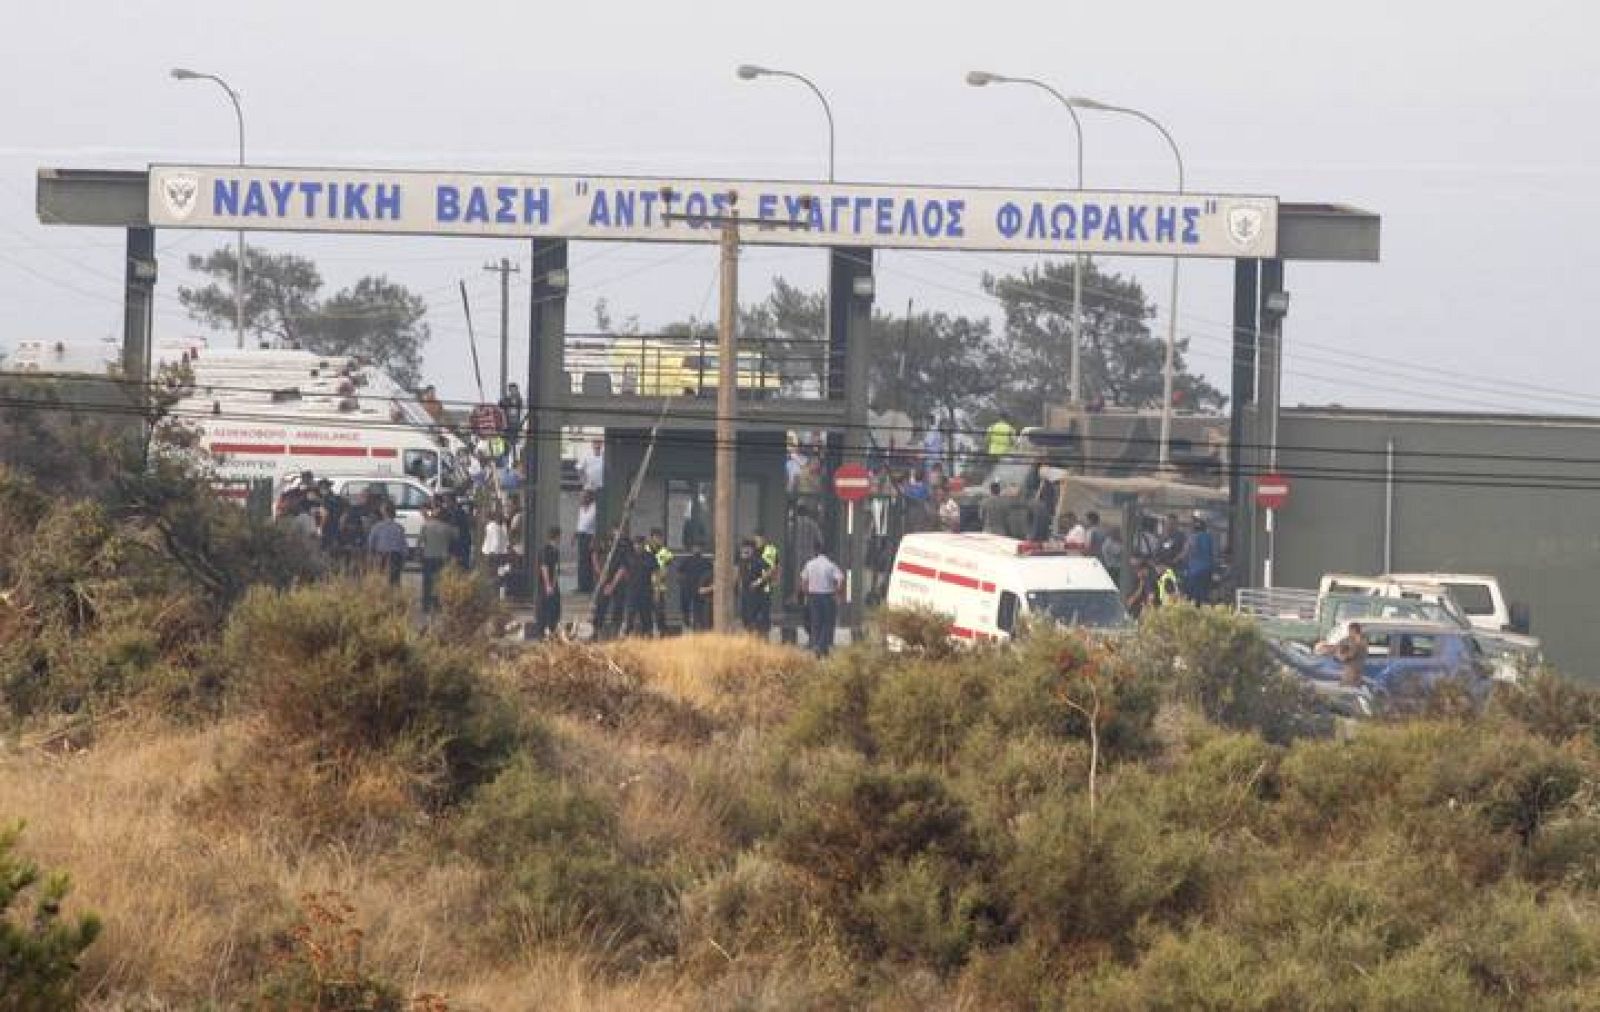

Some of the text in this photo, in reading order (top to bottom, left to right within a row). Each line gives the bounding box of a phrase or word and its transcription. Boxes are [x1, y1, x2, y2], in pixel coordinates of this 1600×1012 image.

[213, 179, 401, 221] ΝΑΥΤΙΚΗ
[437, 185, 550, 225] ΒΑΣΗ
[758, 194, 966, 238] ΕΥΑΓΓΕΛΟΣ
[996, 199, 1217, 244] ΦΛΩΡΑΚΗΣ"
